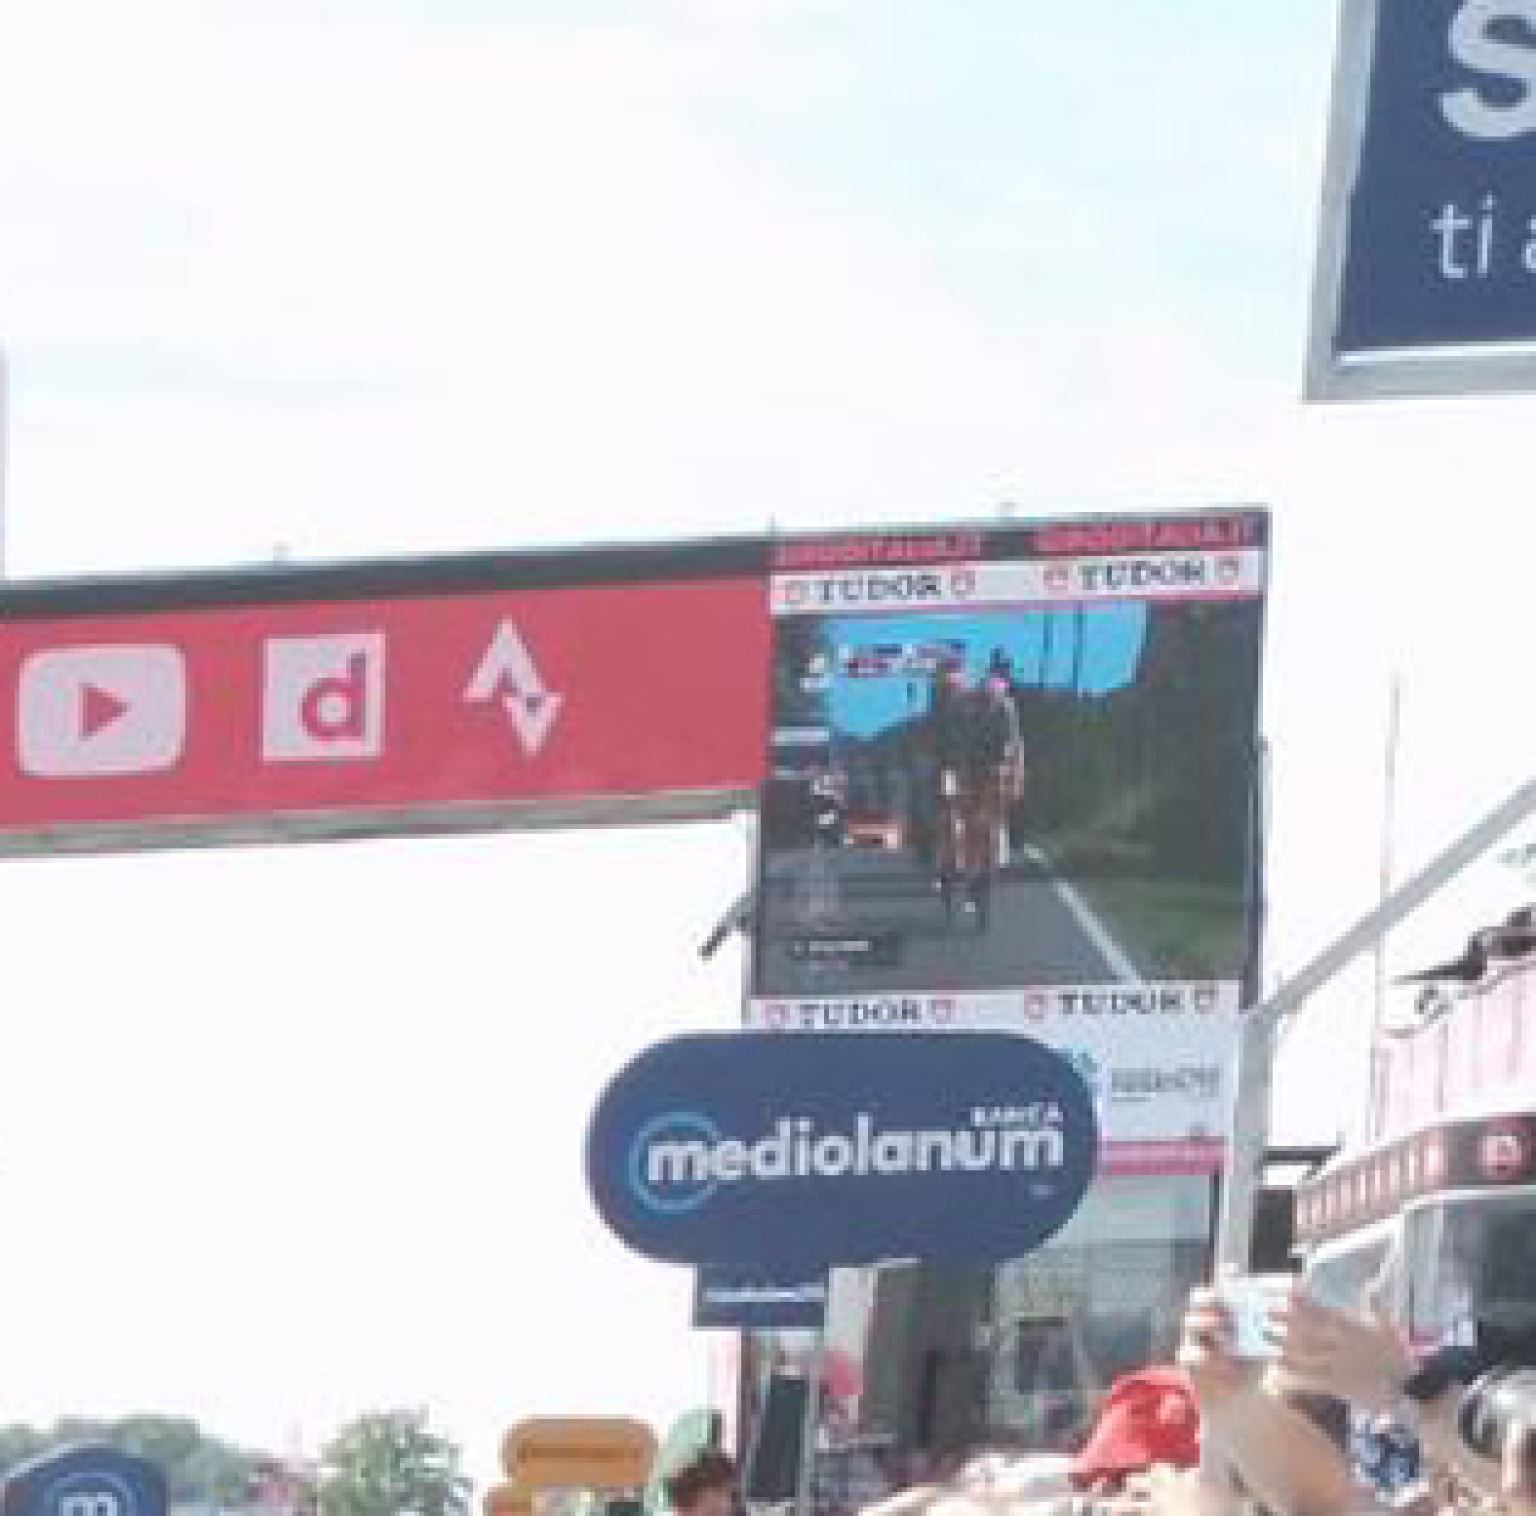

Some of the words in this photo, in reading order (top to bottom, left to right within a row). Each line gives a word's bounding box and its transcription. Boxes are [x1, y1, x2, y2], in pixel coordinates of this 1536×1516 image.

[1429, 190, 1496, 279] ti
[821, 571, 941, 602] TUDOR
[1080, 558, 1205, 591] TUDOR
[799, 1001, 922, 1027] TUDOR
[646, 1115, 1064, 1182] mediolanum
